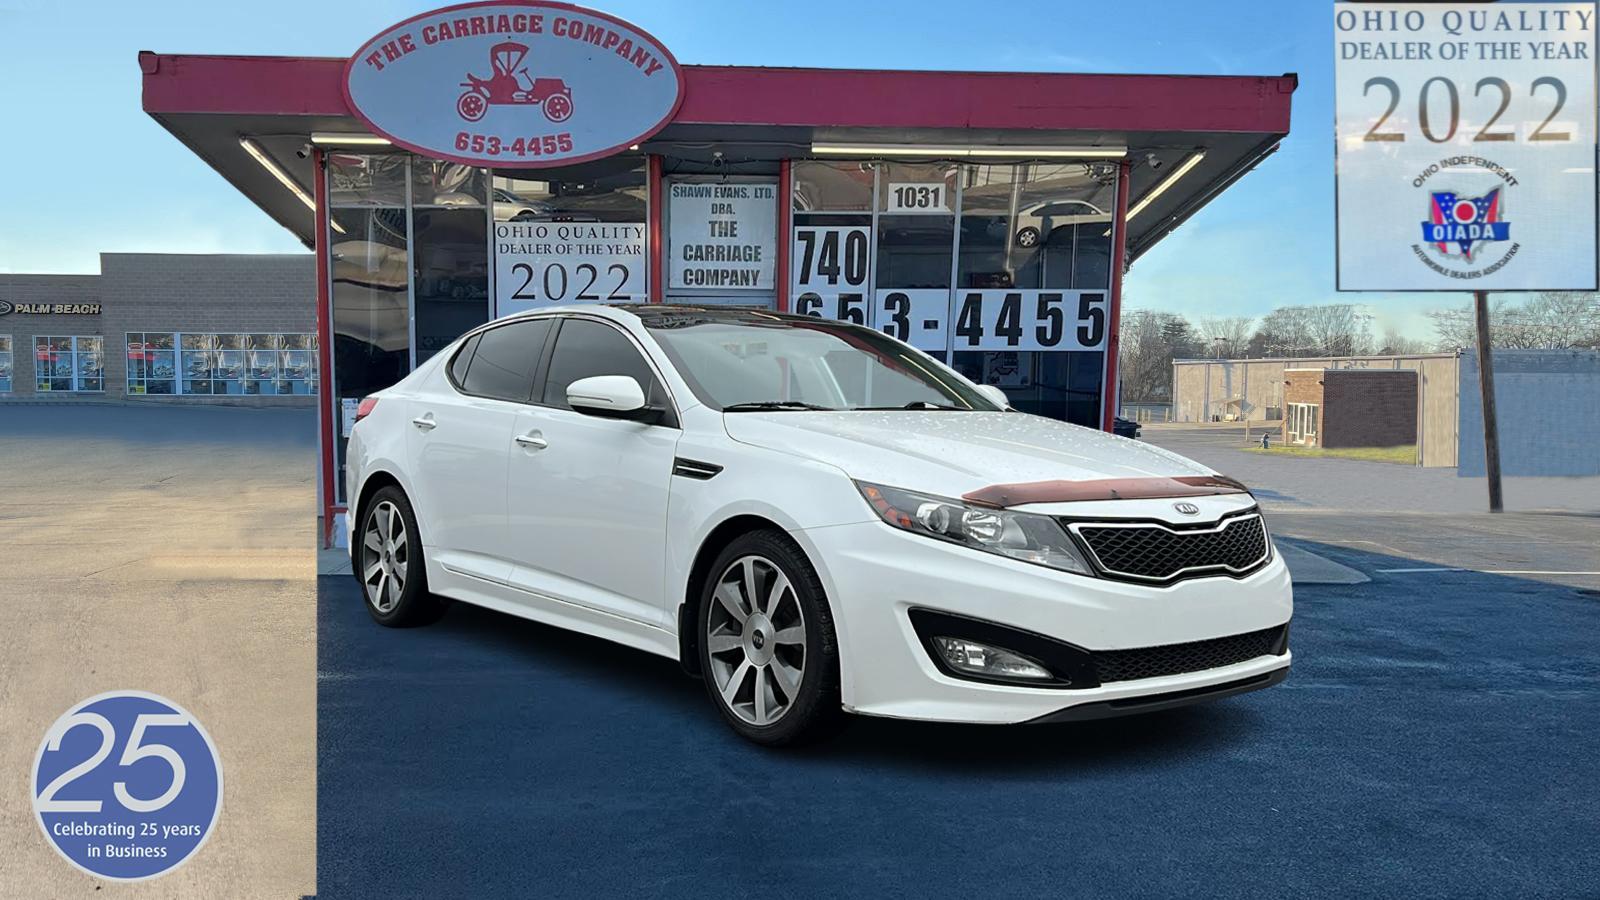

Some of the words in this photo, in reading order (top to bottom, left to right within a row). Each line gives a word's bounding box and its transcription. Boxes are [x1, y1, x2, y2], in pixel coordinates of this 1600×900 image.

[1336, 10, 1425, 32] OHIO
[1442, 10, 1593, 35] QUALITY
[365, 33, 417, 72] THE
[422, 14, 544, 46] CARRIAGE
[552, 16, 665, 77] COMPANY
[1340, 42, 1433, 60] DEALER
[1439, 42, 1469, 60] OF
[1475, 41, 1522, 60] THE
[1528, 41, 1589, 60] YEAR
[1362, 76, 1571, 143] 2022
[454, 131, 574, 156] 653-4455
[1412, 164, 1440, 188] OHIO
[1440, 155, 1519, 187] INDEPENDENT
[672, 186, 712, 199] SHAWN
[754, 187, 775, 200] LTD.
[894, 186, 940, 208] 1031
[711, 203, 736, 215] DBA.
[497, 226, 548, 239] OHIO
[557, 226, 644, 241] QUALITY
[708, 220, 738, 238] THE
[1433, 224, 1495, 240] OIADA
[499, 243, 552, 255] DEALER
[555, 243, 573, 255] OF
[576, 244, 604, 255] THE
[606, 244, 641, 255] YEAR
[682, 245, 762, 262] CARRIAGE
[797, 230, 868, 286] 740
[1411, 243, 1449, 277] AUTOMOBILE
[1449, 268, 1482, 280] DEALERS
[1483, 242, 1521, 277] ASSOCIATION
[511, 262, 631, 301] 2022
[683, 268, 760, 286] COMPANY
[15, 303, 51, 314] PALM
[54, 304, 100, 314] BEACH
[1175, 503, 1199, 514] KIA
